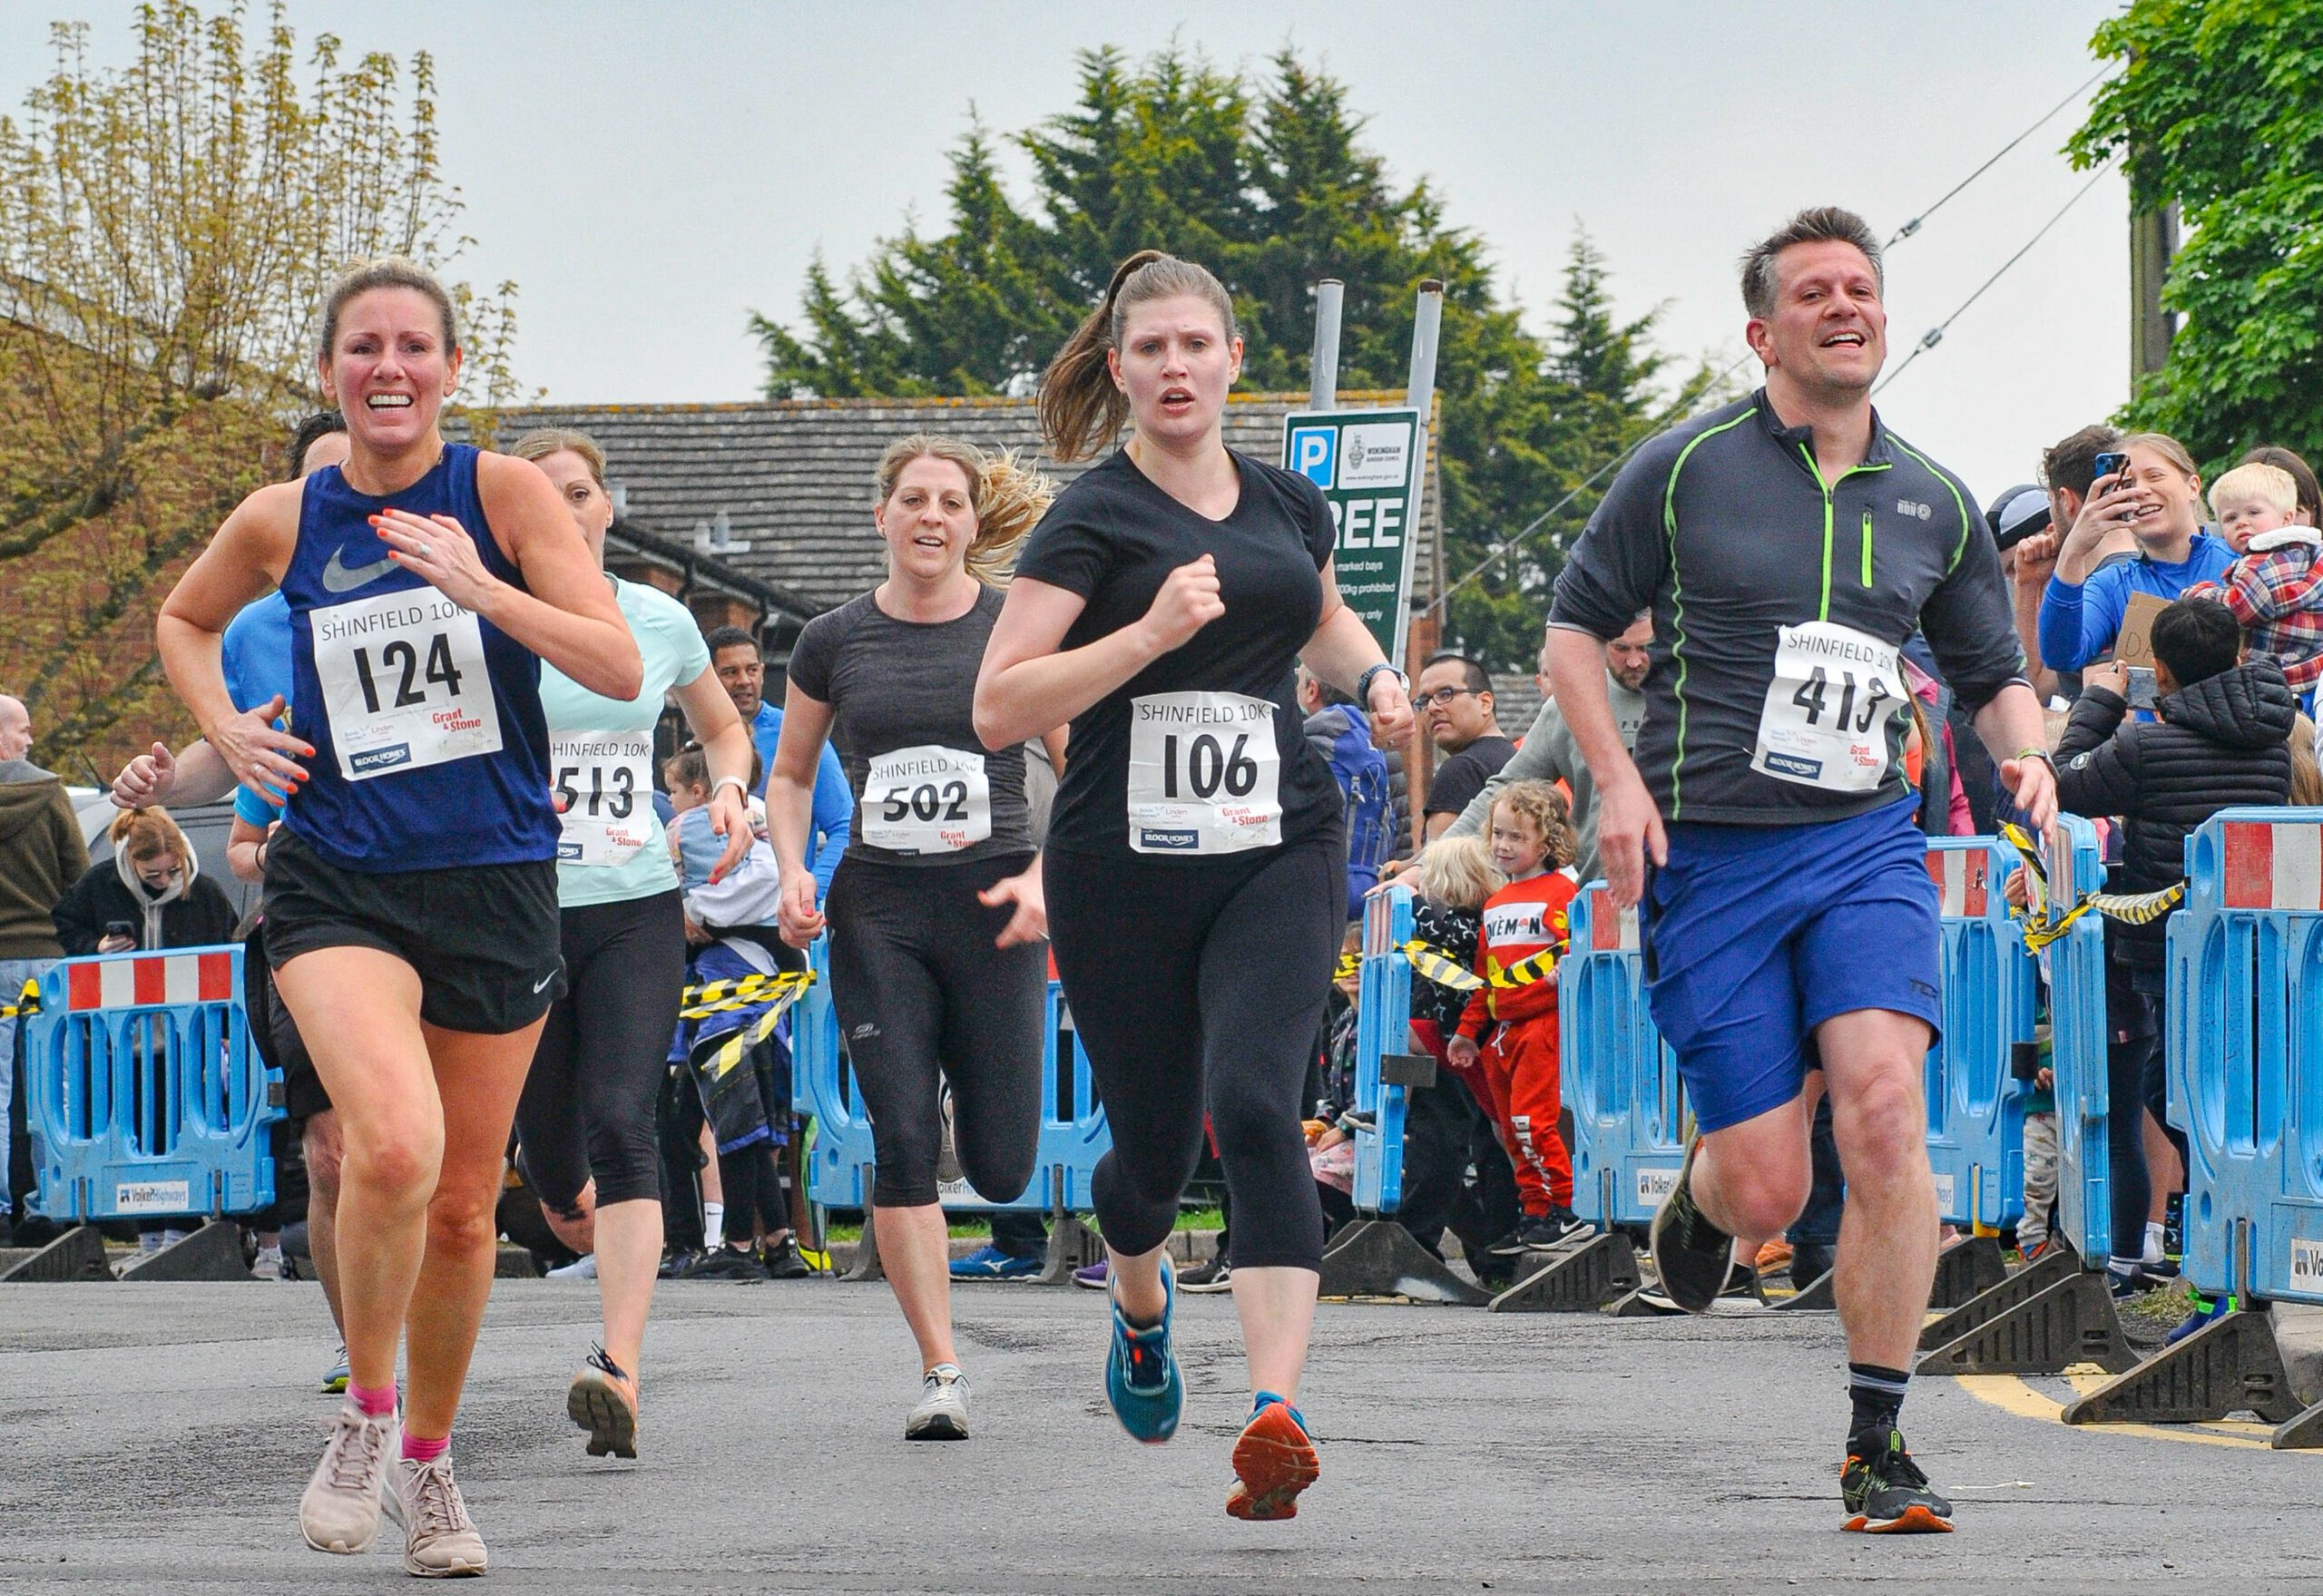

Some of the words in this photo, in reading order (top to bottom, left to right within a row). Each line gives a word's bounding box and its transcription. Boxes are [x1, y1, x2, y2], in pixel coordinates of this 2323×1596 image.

[1299, 436, 1328, 476] P
[1329, 498, 1403, 550] REE
[1365, 561, 1383, 573] bays
[1358, 582, 1397, 595] prohibited
[322, 606, 423, 641] SHINFIELD
[1367, 609, 1383, 622] only
[1788, 633, 1874, 663] SHINFIELD
[353, 633, 463, 714] 124
[1792, 666, 1890, 733] 413
[432, 708, 463, 724] Grant
[1141, 703, 1233, 723] SHINFIELD
[1240, 703, 1267, 721] 10K
[450, 719, 481, 732] Stone
[553, 742, 618, 757] HINFIELD
[623, 742, 650, 757] 10K
[872, 758, 948, 781] SHINFIELD
[1164, 734, 1258, 798] 106
[556, 767, 634, 819] 513
[883, 780, 968, 822] 502
[1222, 807, 1250, 817] Grant
[1239, 815, 1269, 826] Stone
[605, 827, 629, 836] Grant
[940, 830, 965, 840] Grant
[617, 837, 642, 847] Stone
[131, 1186, 185, 1204] VolkerHighways
